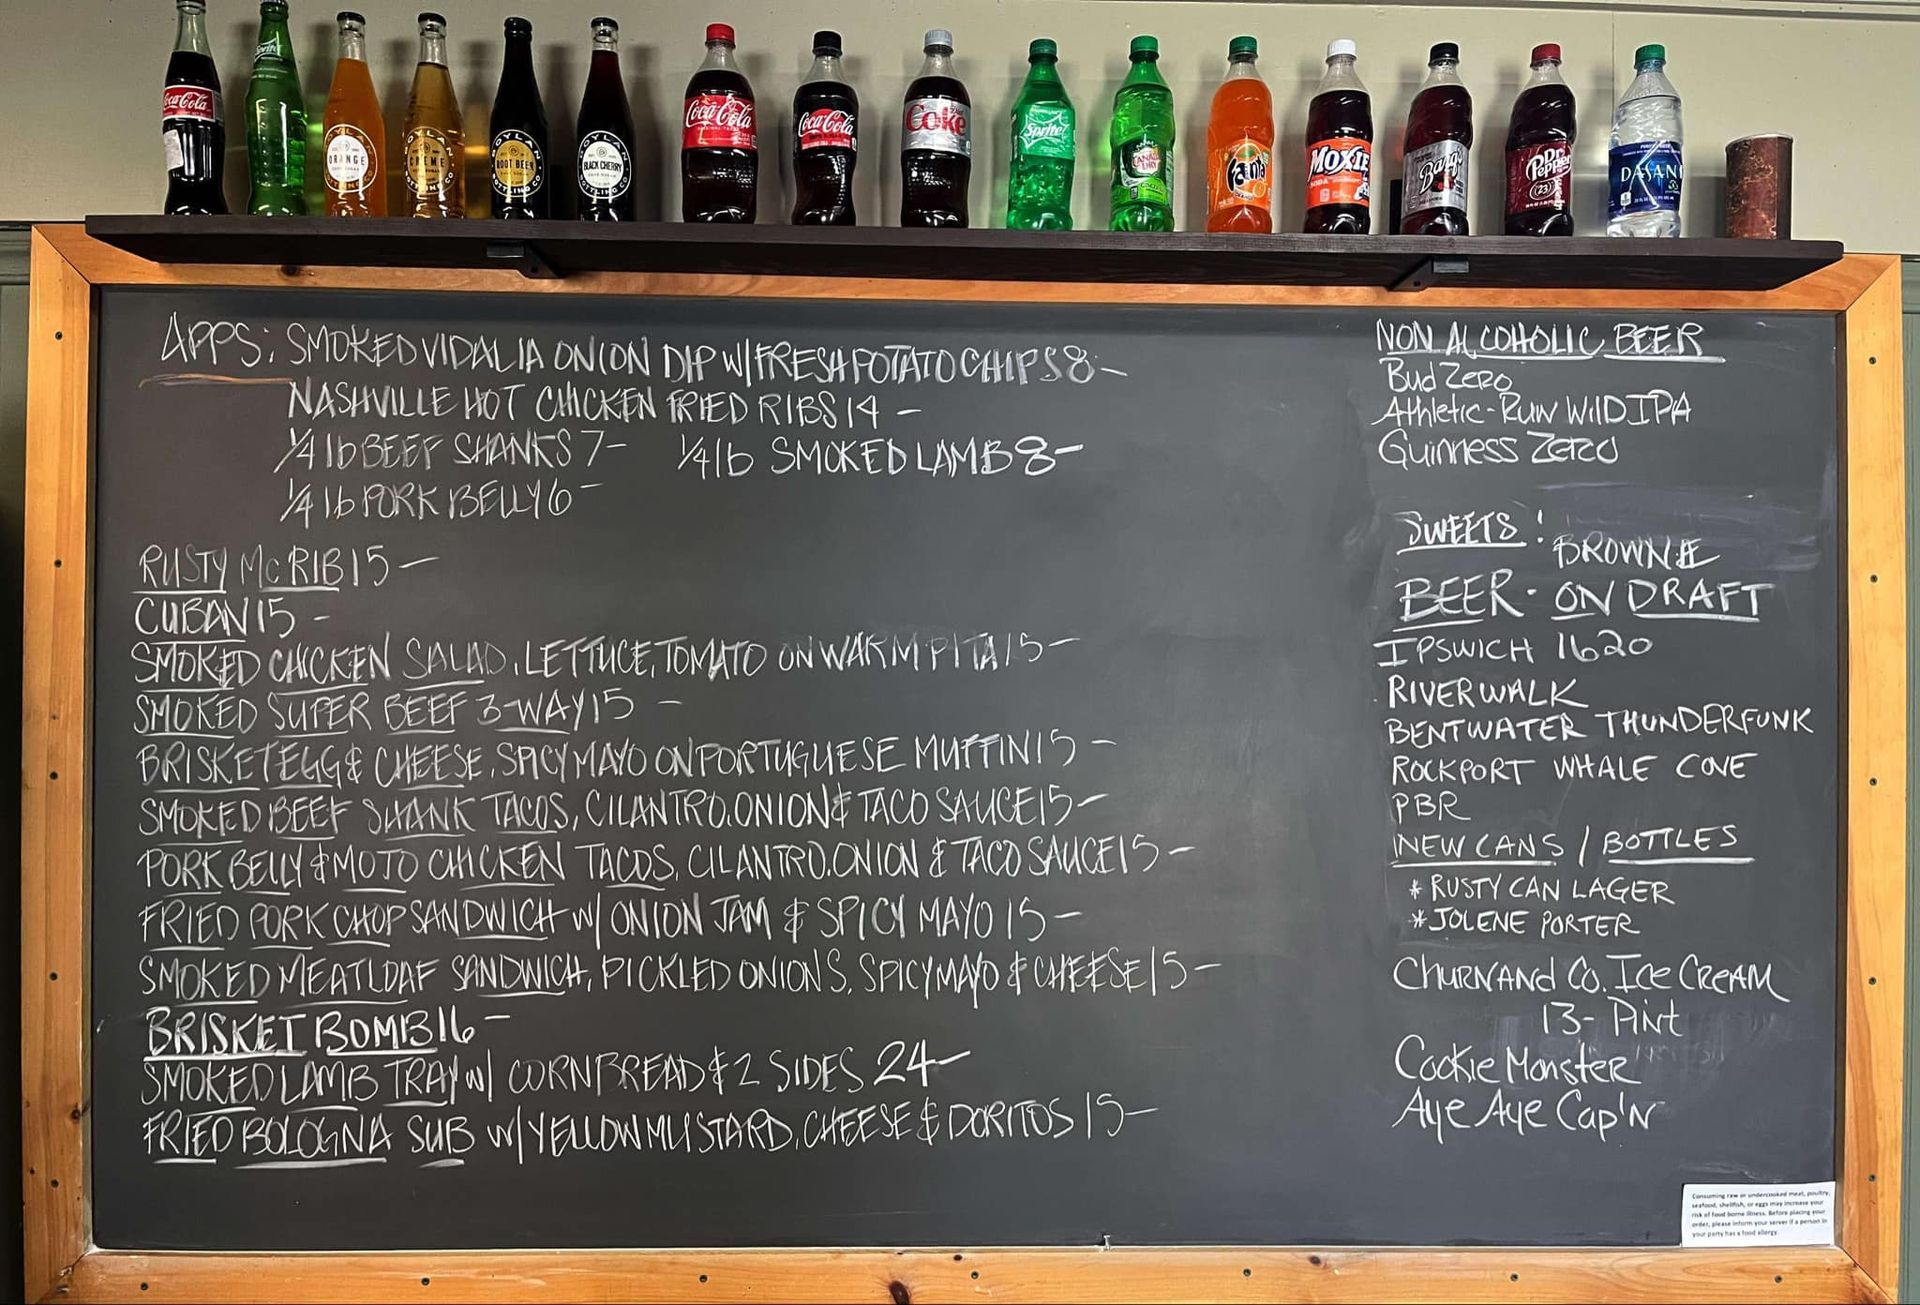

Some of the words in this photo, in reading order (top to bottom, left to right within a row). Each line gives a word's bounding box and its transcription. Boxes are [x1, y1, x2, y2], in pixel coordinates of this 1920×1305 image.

[686, 98, 754, 129] Coca-Cola
[798, 109, 856, 138] Coca-Cola
[905, 103, 967, 137] Coke
[1025, 121, 1064, 138] Sprite
[515, 159, 535, 171] BEER
[583, 161, 600, 171] BLACK
[600, 160, 623, 172] CHERRY
[1226, 154, 1266, 193] Fanta
[1307, 145, 1370, 185] MOXIE
[1419, 147, 1464, 195] Barq's
[1531, 153, 1571, 182] Pepper
[1544, 148, 1565, 164] Dr
[1621, 164, 1683, 183] DASANI
[1537, 183, 1549, 194] 23
[287, 322, 417, 367] SMOKED
[422, 333, 544, 373] VIDALIA
[553, 334, 650, 376] ONION
[663, 345, 714, 384] DIP
[1376, 320, 1434, 354] NON
[1445, 320, 1604, 359] ALCOHOLIC
[1613, 323, 1704, 357] BEER
[1380, 358, 1436, 393] Bud
[288, 381, 458, 419] NASHVILLE
[464, 384, 525, 420] HOT
[536, 381, 656, 422] CHICKEN
[667, 390, 748, 425] FRIED
[759, 393, 836, 428] RIBS
[1627, 389, 1692, 425] IPA
[363, 434, 444, 469] BEEF
[454, 429, 571, 467] SHANKS
[771, 437, 907, 476] SMOKED
[917, 436, 1013, 477] LAMB
[1378, 429, 1520, 470] Guinness
[363, 484, 440, 518] PORK
[448, 483, 541, 519] BELLY
[139, 545, 228, 588] RUSTY
[1553, 531, 1720, 569] BROWNIE
[1395, 568, 1524, 621] BEER
[1555, 580, 1615, 616] ON
[1628, 578, 1776, 617] DRAFT
[135, 597, 247, 636] CUBAN
[131, 642, 260, 688] SMOKED
[268, 634, 389, 682] CHICKEN
[655, 638, 766, 681] TOMATO
[779, 638, 812, 670] ON
[1372, 636, 1533, 666] IPSWICH
[1558, 630, 1652, 662] 1620
[1388, 674, 1589, 708] RIVERWALK
[134, 694, 257, 733] SMOKED
[268, 692, 371, 730] SUPER
[385, 692, 471, 731] BEEF
[1384, 714, 1588, 748] BENTWATER
[1595, 703, 1814, 738] THUNDERFUNK
[136, 741, 278, 785] BRISKET
[497, 742, 568, 782] SPICY
[574, 737, 647, 779] MAYO
[696, 738, 906, 778] PORTUGUESE
[1392, 756, 1535, 786] ROCKPORT
[1553, 753, 1658, 780] WHALE
[1676, 752, 1758, 779] COVE
[139, 797, 261, 838] SMOKED
[269, 796, 352, 833] BEEF
[362, 797, 477, 835] SHANK
[857, 792, 928, 828] TACO
[1392, 792, 1470, 821] PBR
[1392, 832, 1464, 859] NEW
[1476, 833, 1564, 858] CANS
[1602, 824, 1737, 854] BOTTLES
[137, 848, 222, 887] PORK
[228, 844, 302, 888] BELLY
[428, 841, 566, 882] CHICKEN
[950, 836, 1022, 878] TACO
[1028, 835, 1115, 875] SAUCE
[1509, 876, 1560, 900] CAN
[1572, 877, 1675, 904] LAGER
[137, 899, 239, 945] FRIED
[249, 902, 330, 941] PORK
[332, 904, 408, 939] CHOP
[411, 898, 570, 939] SANDWICH
[610, 892, 700, 939] ONION
[712, 895, 771, 939] JAM
[820, 895, 905, 940] SPICY
[918, 895, 993, 939] MAYO
[1540, 911, 1640, 938] PORTER
[139, 955, 270, 1000] SMOKED
[279, 953, 440, 996] MEATLOAF
[601, 950, 728, 993] PICKLED
[1034, 947, 1146, 993] CHEESE
[144, 1006, 307, 1057] BRISKET
[315, 1009, 437, 1048] BOMB
[141, 1061, 274, 1105] SMOKED
[280, 1060, 379, 1105] LAMB
[383, 1055, 458, 1105] TRAY
[768, 1046, 863, 1092] SIDES
[143, 1113, 234, 1155] FRIED
[242, 1110, 392, 1159] BOLOGNA
[407, 1115, 475, 1153] SUB
[527, 1110, 642, 1159] YELLOW
[948, 1097, 1074, 1140] DORITOS
[1393, 1086, 1470, 1144] Aye
[1476, 1088, 1547, 1135] Aye
